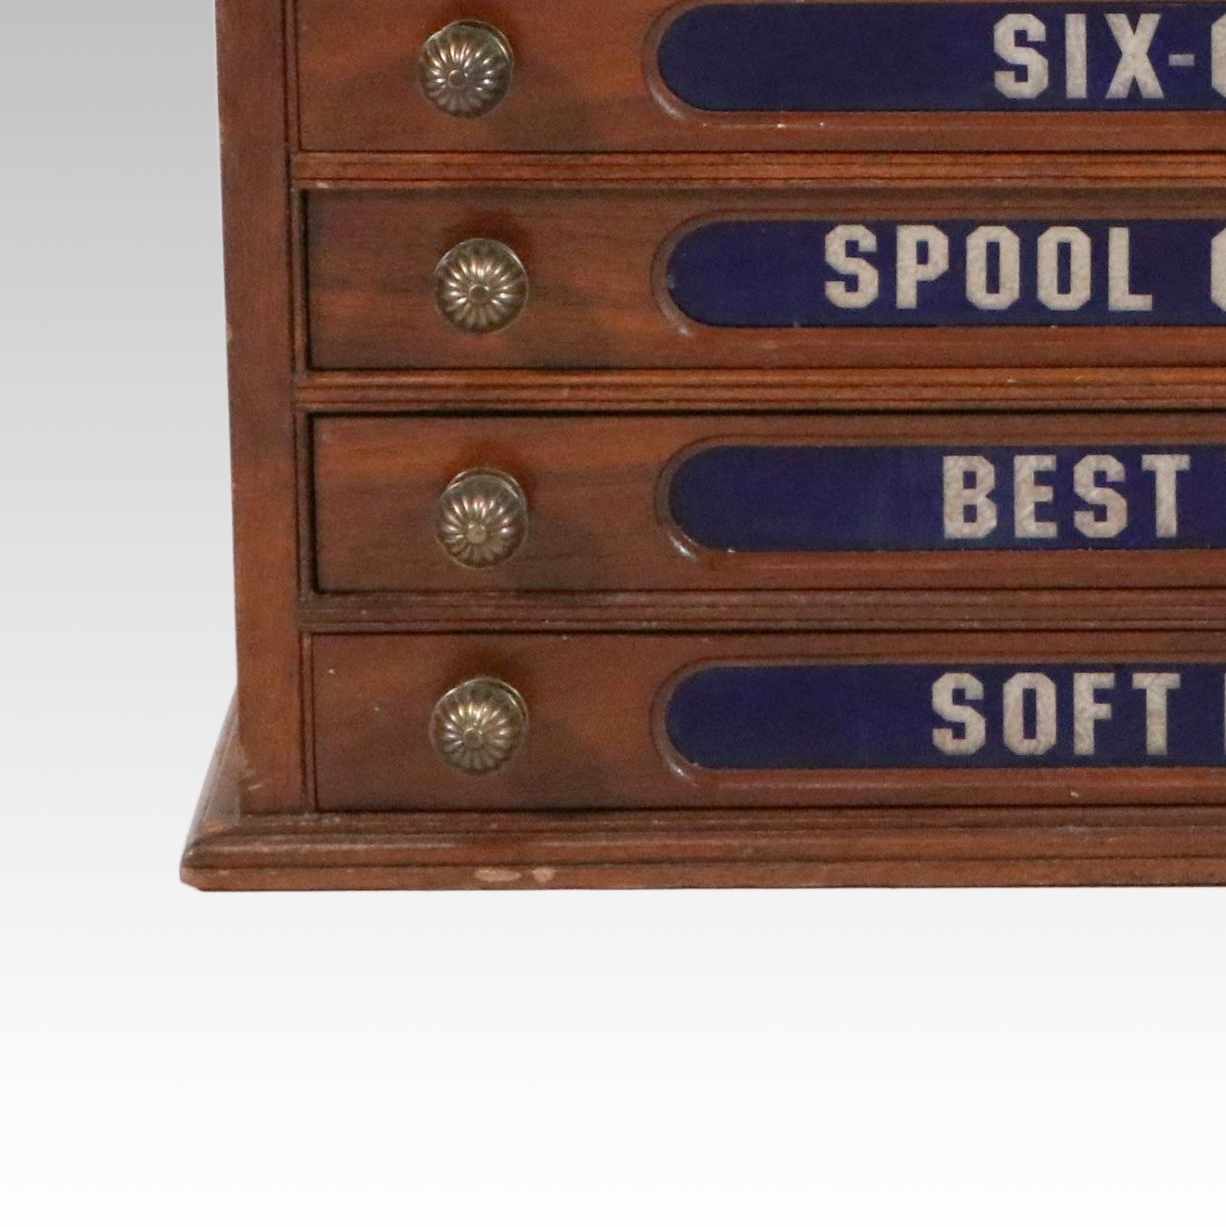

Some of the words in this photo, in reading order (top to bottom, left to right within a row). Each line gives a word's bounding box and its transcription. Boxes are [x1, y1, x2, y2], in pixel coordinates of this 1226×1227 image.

[824, 224, 1153, 312] SPOOL
[942, 453, 1191, 540] BEST
[930, 671, 1181, 757] SOFT
